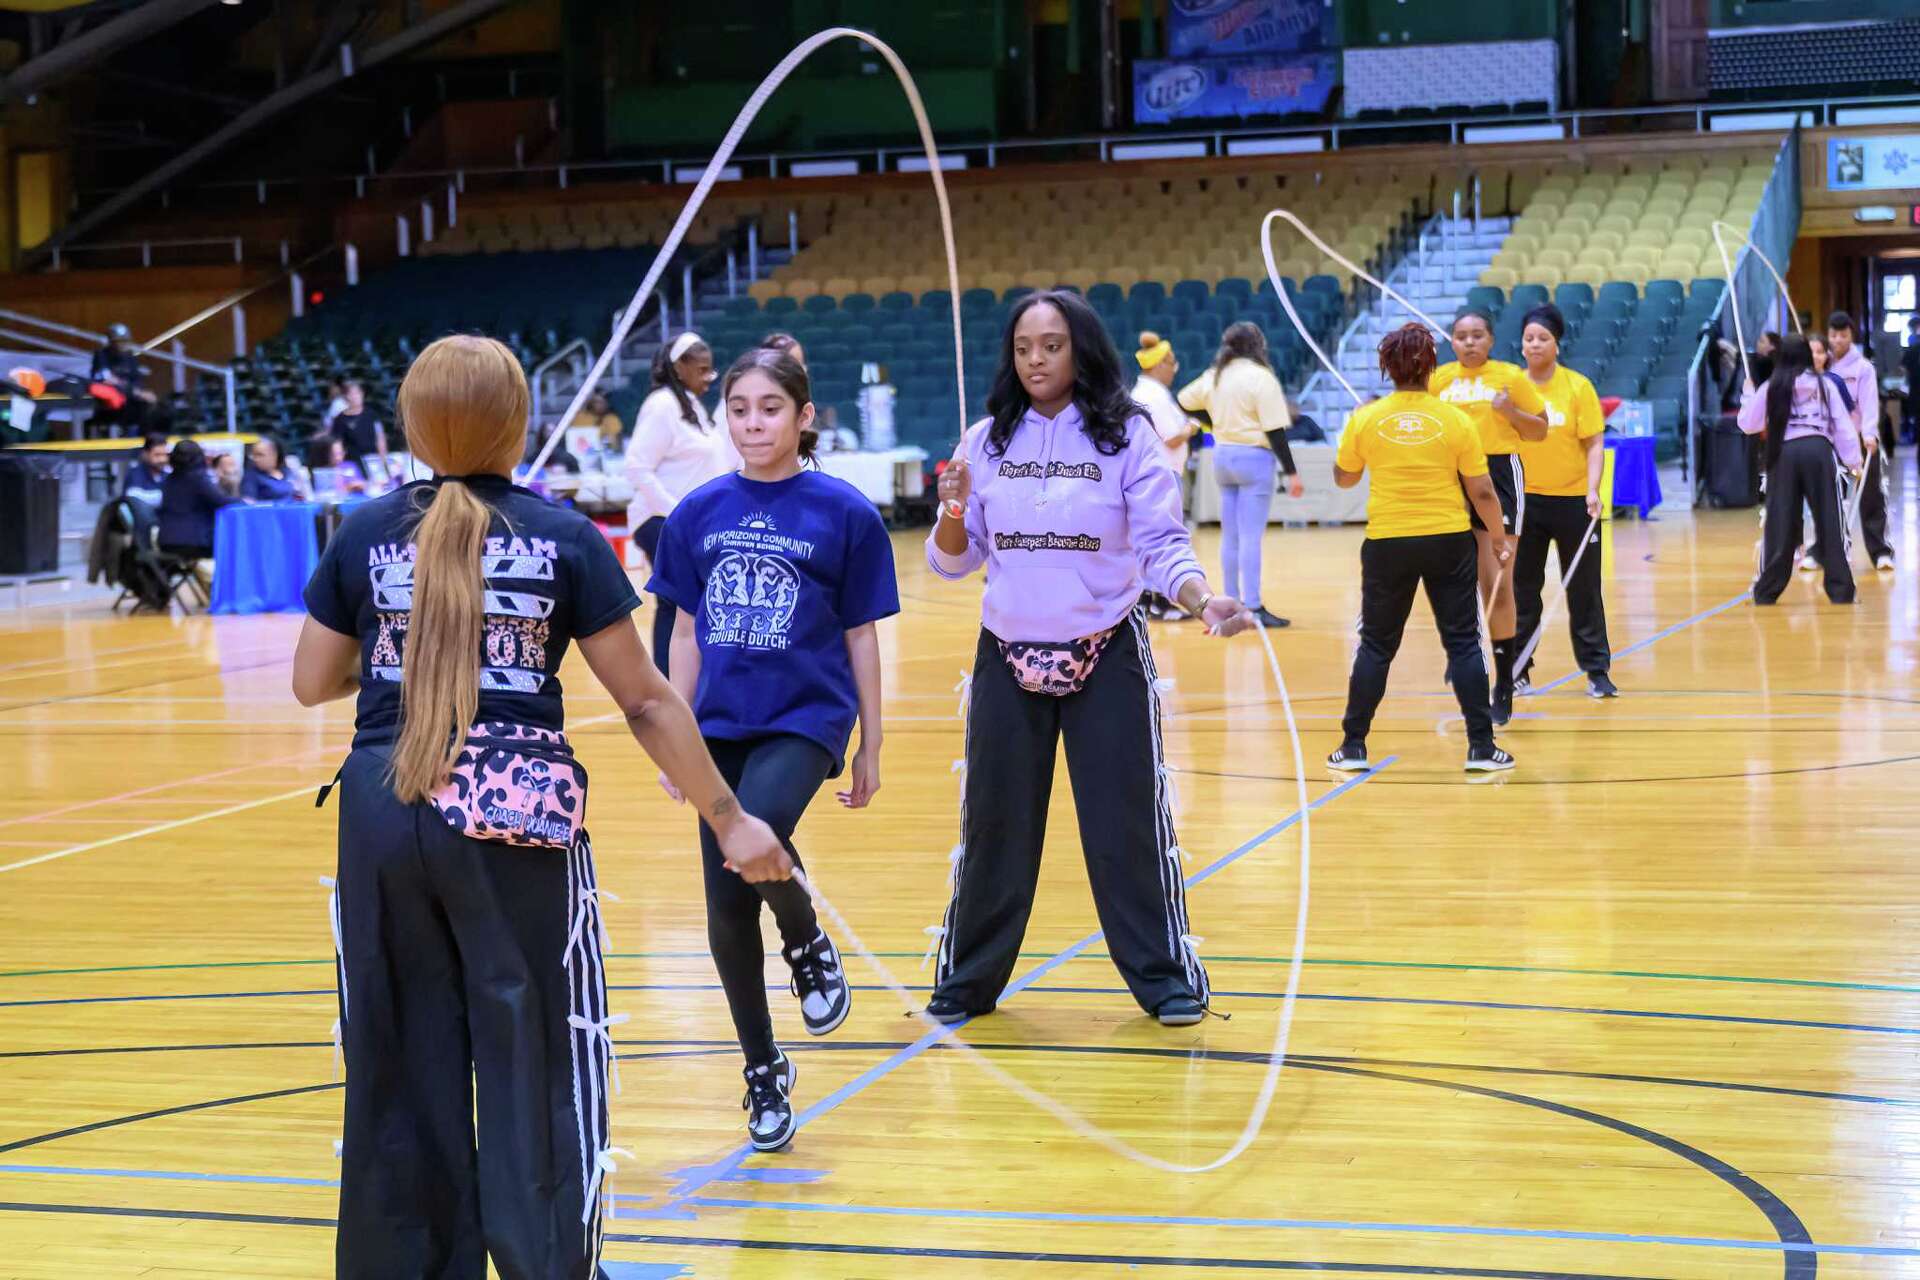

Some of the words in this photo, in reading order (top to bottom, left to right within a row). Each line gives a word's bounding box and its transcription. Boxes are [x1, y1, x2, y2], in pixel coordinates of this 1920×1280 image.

[703, 535, 717, 553] NEW
[717, 530, 761, 542] HORIZONS
[763, 534, 815, 559] COMMUNITY
[756, 542, 784, 552] SCHOOL
[707, 631, 746, 644] DOUBLE
[748, 632, 787, 650] DUTCH
[485, 806, 523, 827] COACH
